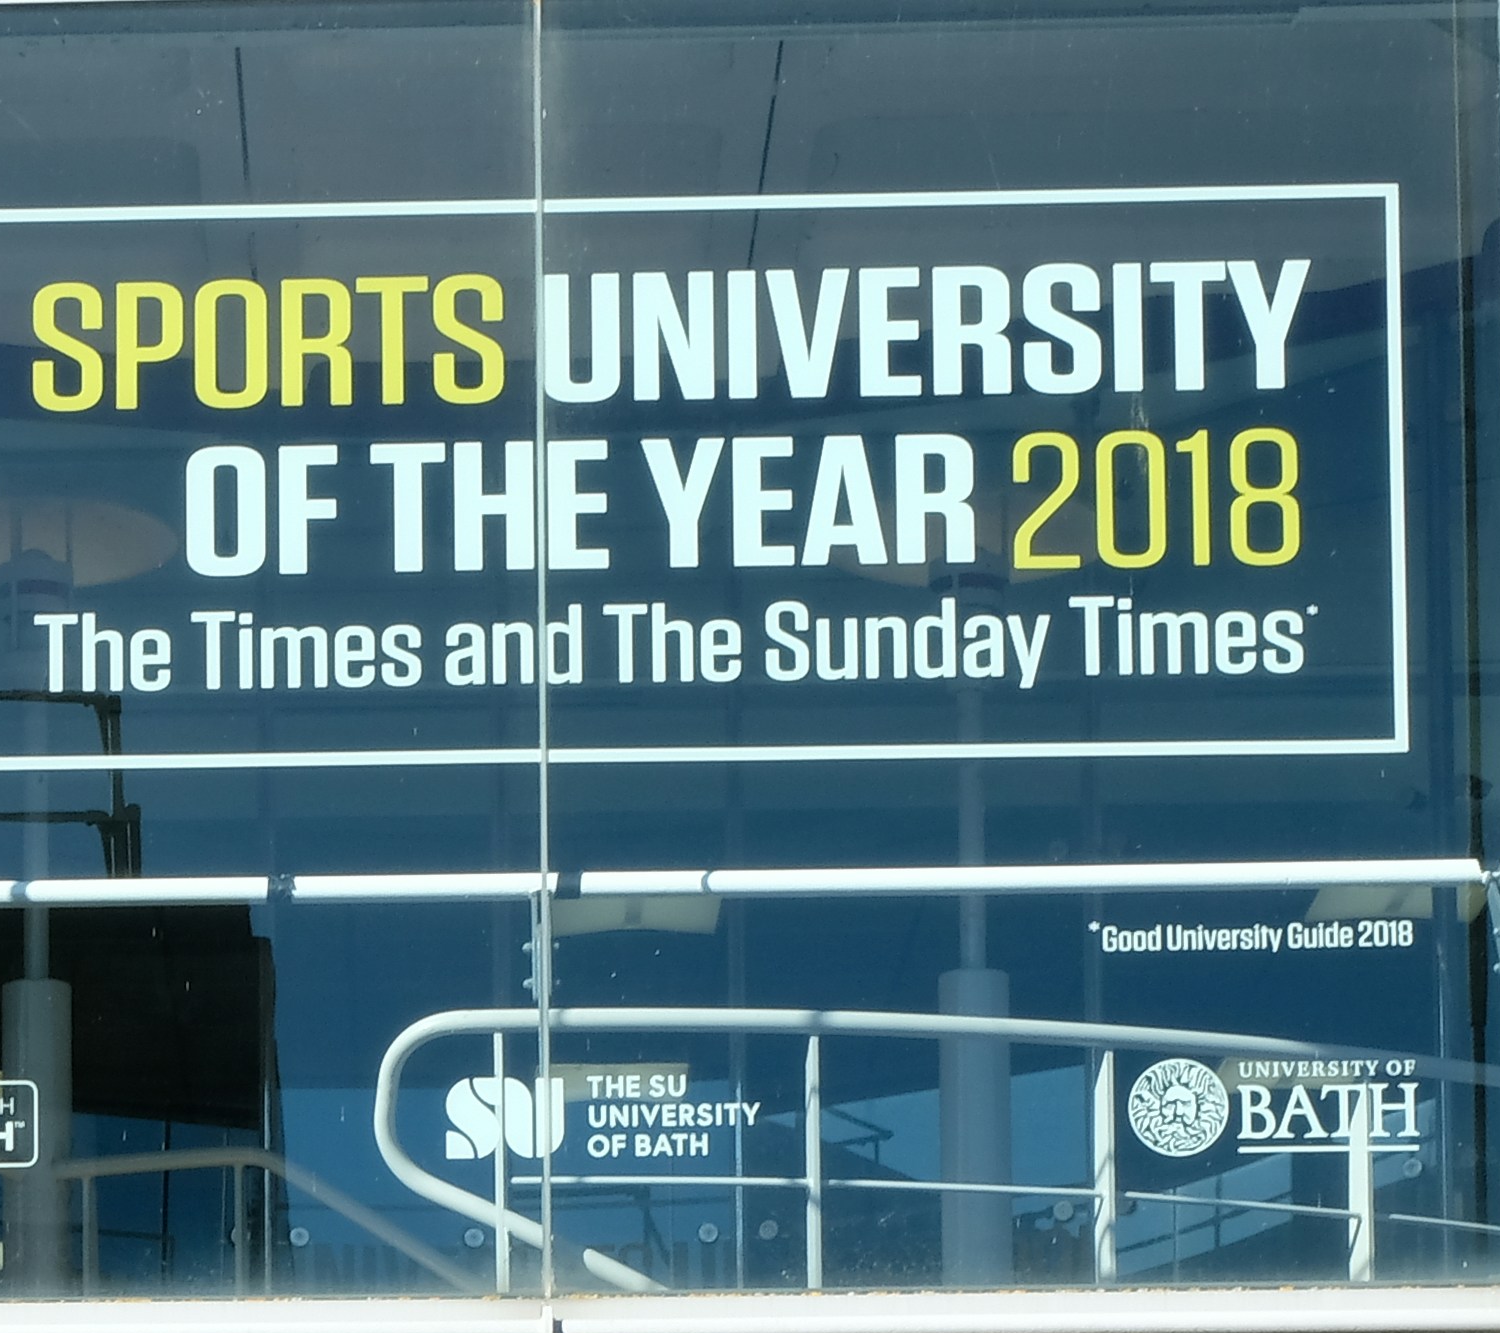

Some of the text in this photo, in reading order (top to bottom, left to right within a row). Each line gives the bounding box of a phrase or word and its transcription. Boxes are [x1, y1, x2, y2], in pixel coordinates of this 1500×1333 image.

[32, 259, 1311, 412] SPORTS UNIVERSITY
[185, 427, 1300, 577] OF THE YEAR 2018
[33, 612, 171, 693] The
[190, 610, 422, 690] Times
[445, 603, 583, 687] and
[602, 602, 742, 683] The
[765, 597, 1051, 689] Sunday
[1166, 924, 1283, 953] University
[1287, 921, 1354, 949] Guide
[1357, 919, 1414, 947] 2018
[1238, 1059, 1416, 1078] UNIVERSITY OF
[586, 1074, 687, 1098] THE SU
[588, 1101, 761, 1128] UNIVERSITY
[1236, 1081, 1421, 1140] BATH
[587, 1133, 709, 1158] OF BATH
